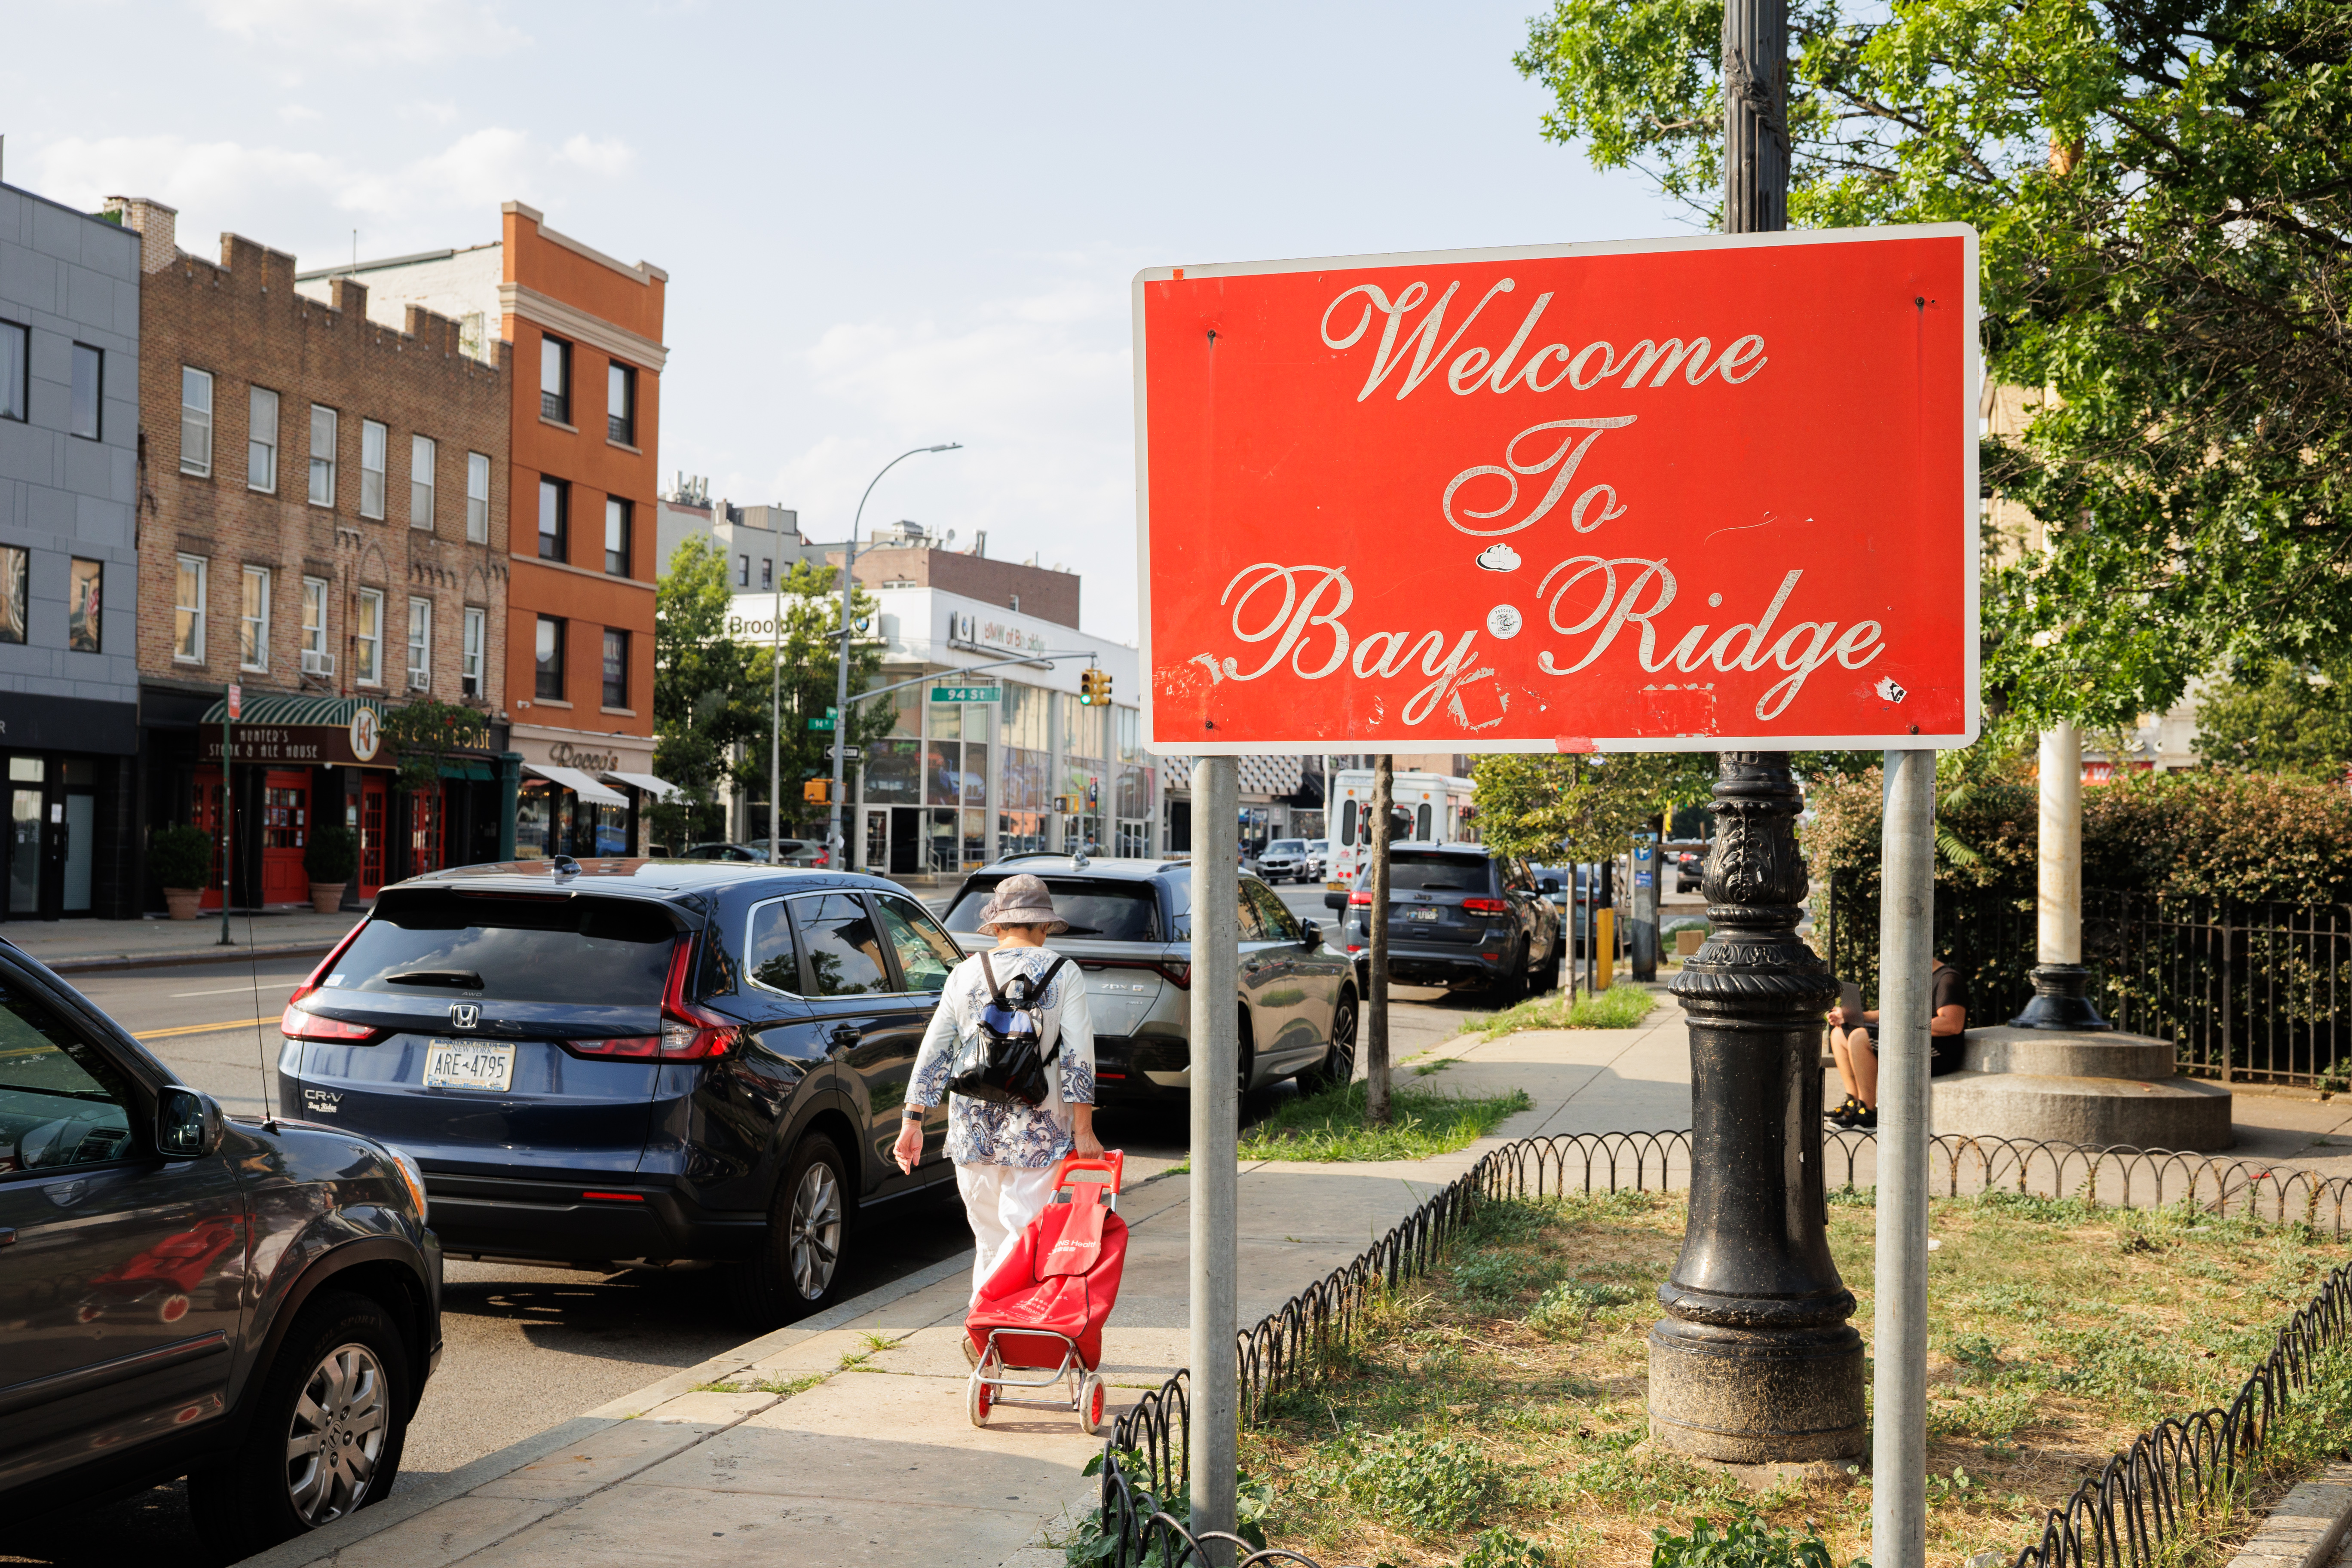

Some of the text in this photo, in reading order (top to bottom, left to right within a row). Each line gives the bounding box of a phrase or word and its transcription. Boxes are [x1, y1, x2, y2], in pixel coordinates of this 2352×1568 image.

[1321, 278, 1768, 402] Welcome
[1443, 414, 1638, 536] To
[984, 622, 1005, 643] BMW
[1006, 628, 1014, 645] of
[1221, 556, 1886, 726] Bay Ridge
[948, 689, 985, 700] 94 St
[240, 729, 288, 743] HUNTER'S
[260, 744, 279, 758] ALE
[286, 745, 318, 758] HOUSE
[549, 742, 619, 772] Rocco's
[472, 1046, 493, 1054] YORK
[304, 1089, 343, 1102] CR-V
[308, 1101, 320, 1111] Bay
[321, 1102, 337, 1111] Ridge
